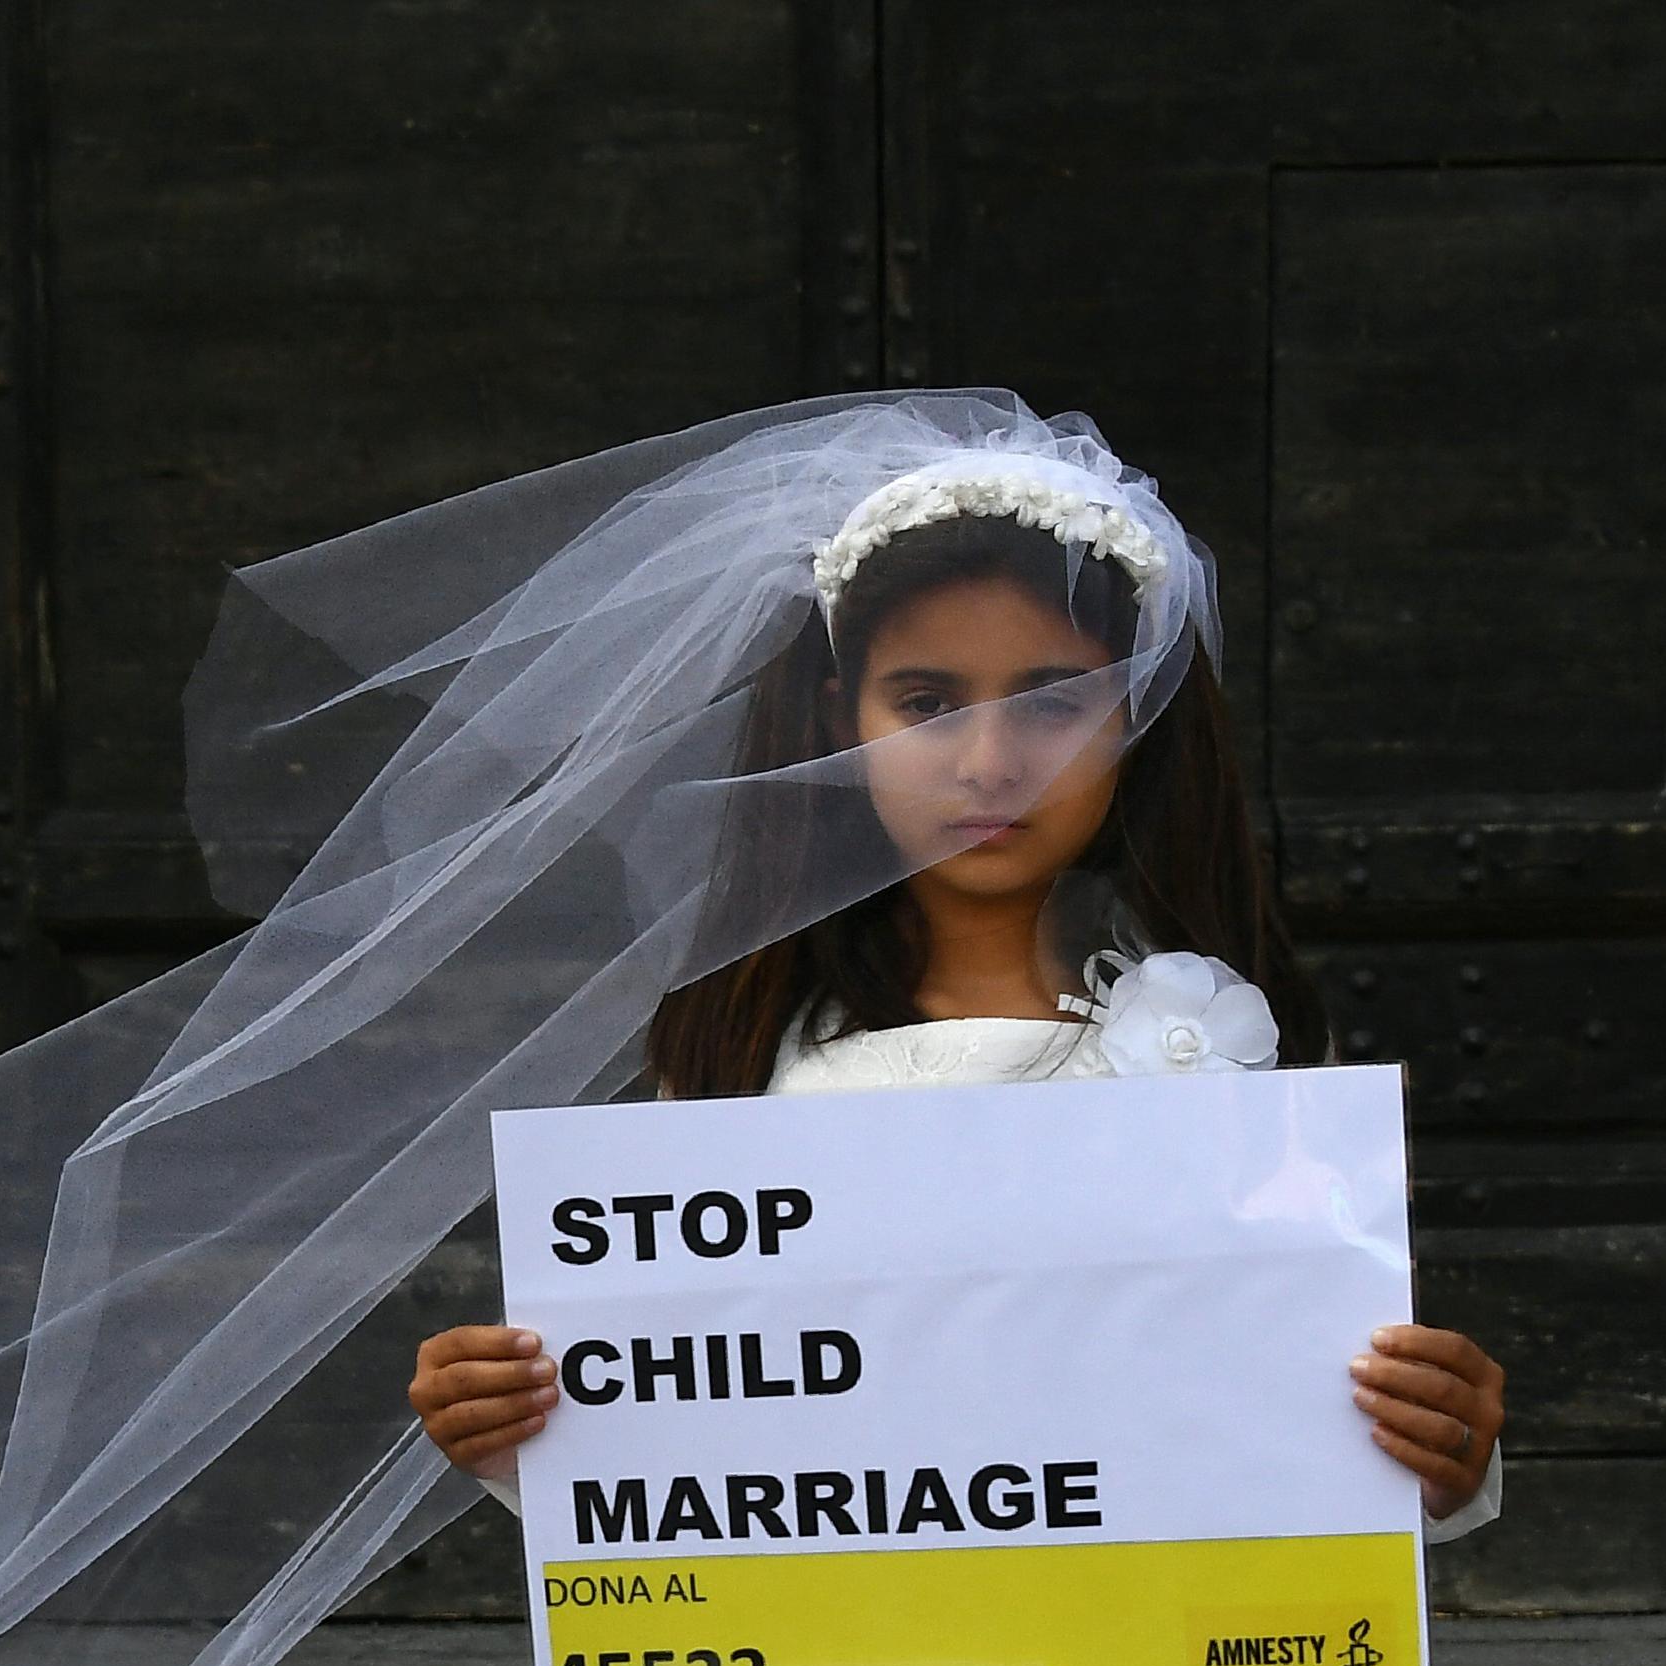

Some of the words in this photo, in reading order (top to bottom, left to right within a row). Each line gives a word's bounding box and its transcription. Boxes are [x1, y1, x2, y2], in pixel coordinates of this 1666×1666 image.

[551, 1188, 813, 1266] STOP
[560, 1329, 863, 1406] CHILD
[572, 1461, 1103, 1545] MARRIAGE
[543, 1575, 653, 1608] DONA
[663, 1573, 708, 1603] AL
[1205, 1634, 1326, 1666] AMNESTY
